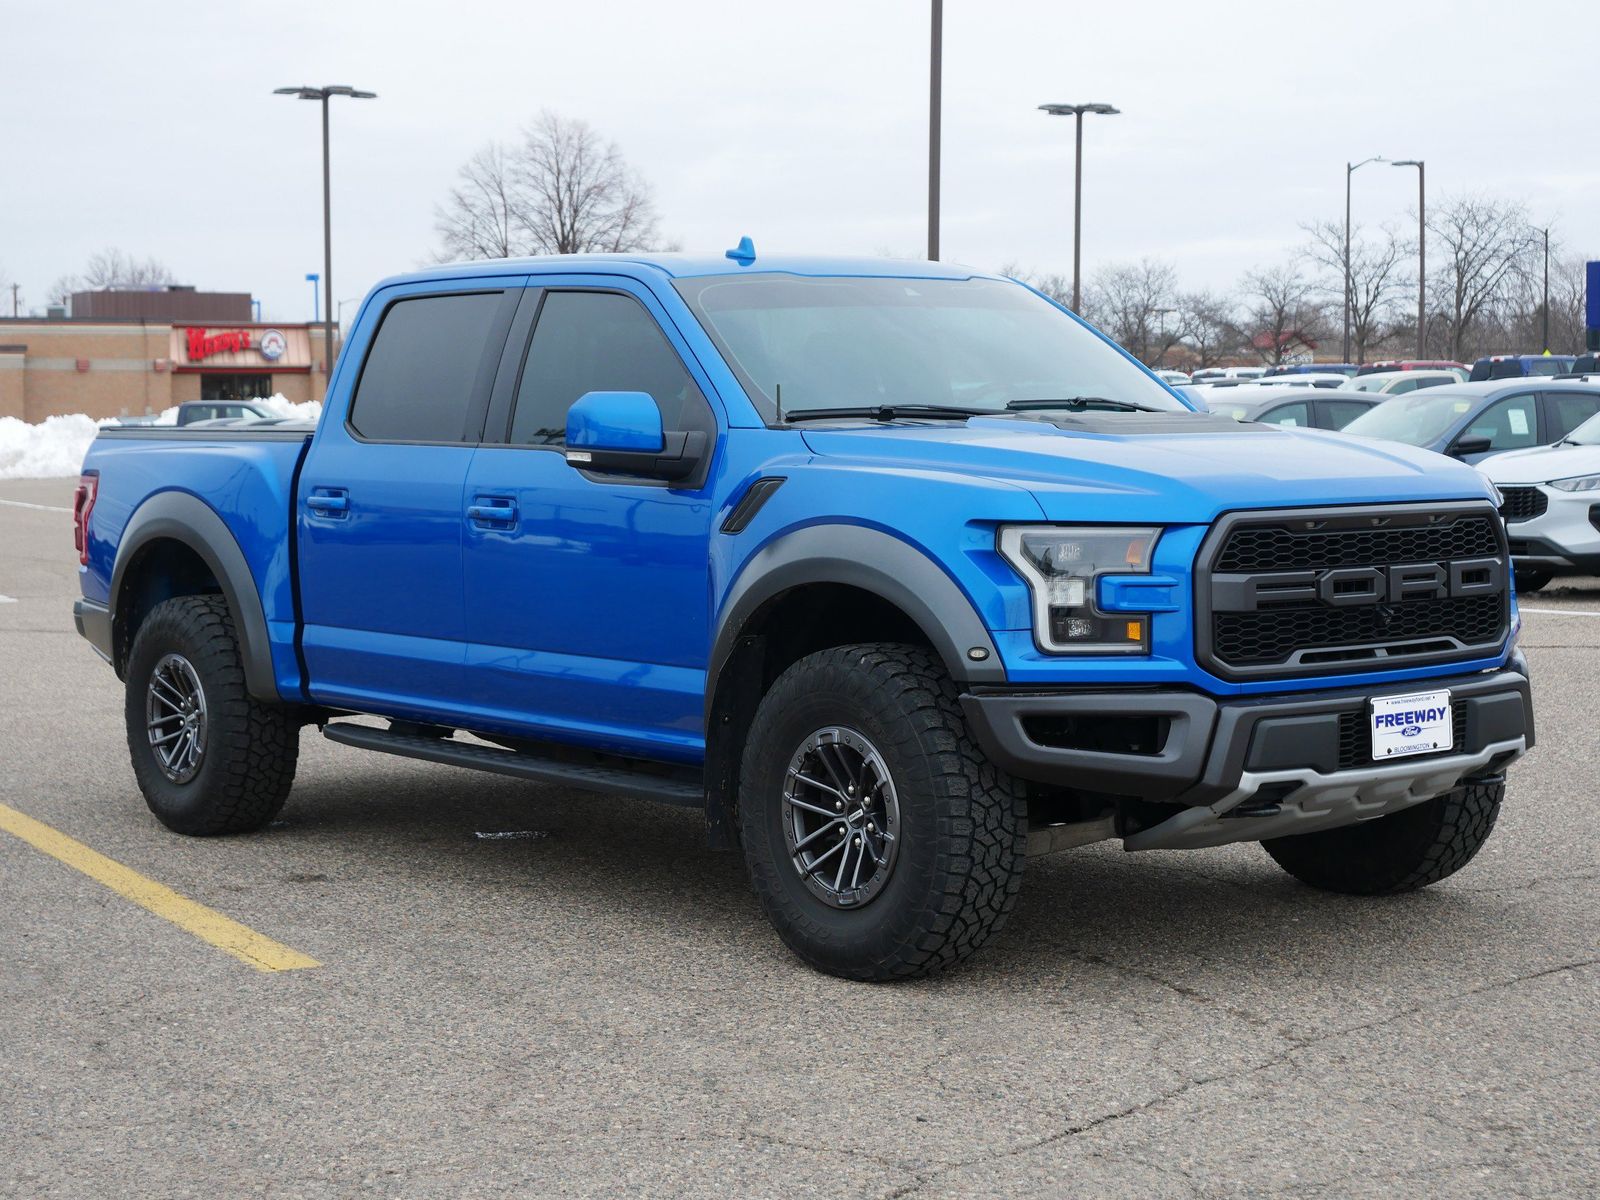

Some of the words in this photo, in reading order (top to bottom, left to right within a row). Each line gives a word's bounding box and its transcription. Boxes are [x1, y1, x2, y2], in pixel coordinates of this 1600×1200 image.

[1245, 558, 1505, 611] FORD
[1375, 707, 1446, 729] FREEWAY
[1403, 726, 1421, 736] Ford
[1394, 743, 1430, 753] BLOOMINGTON
